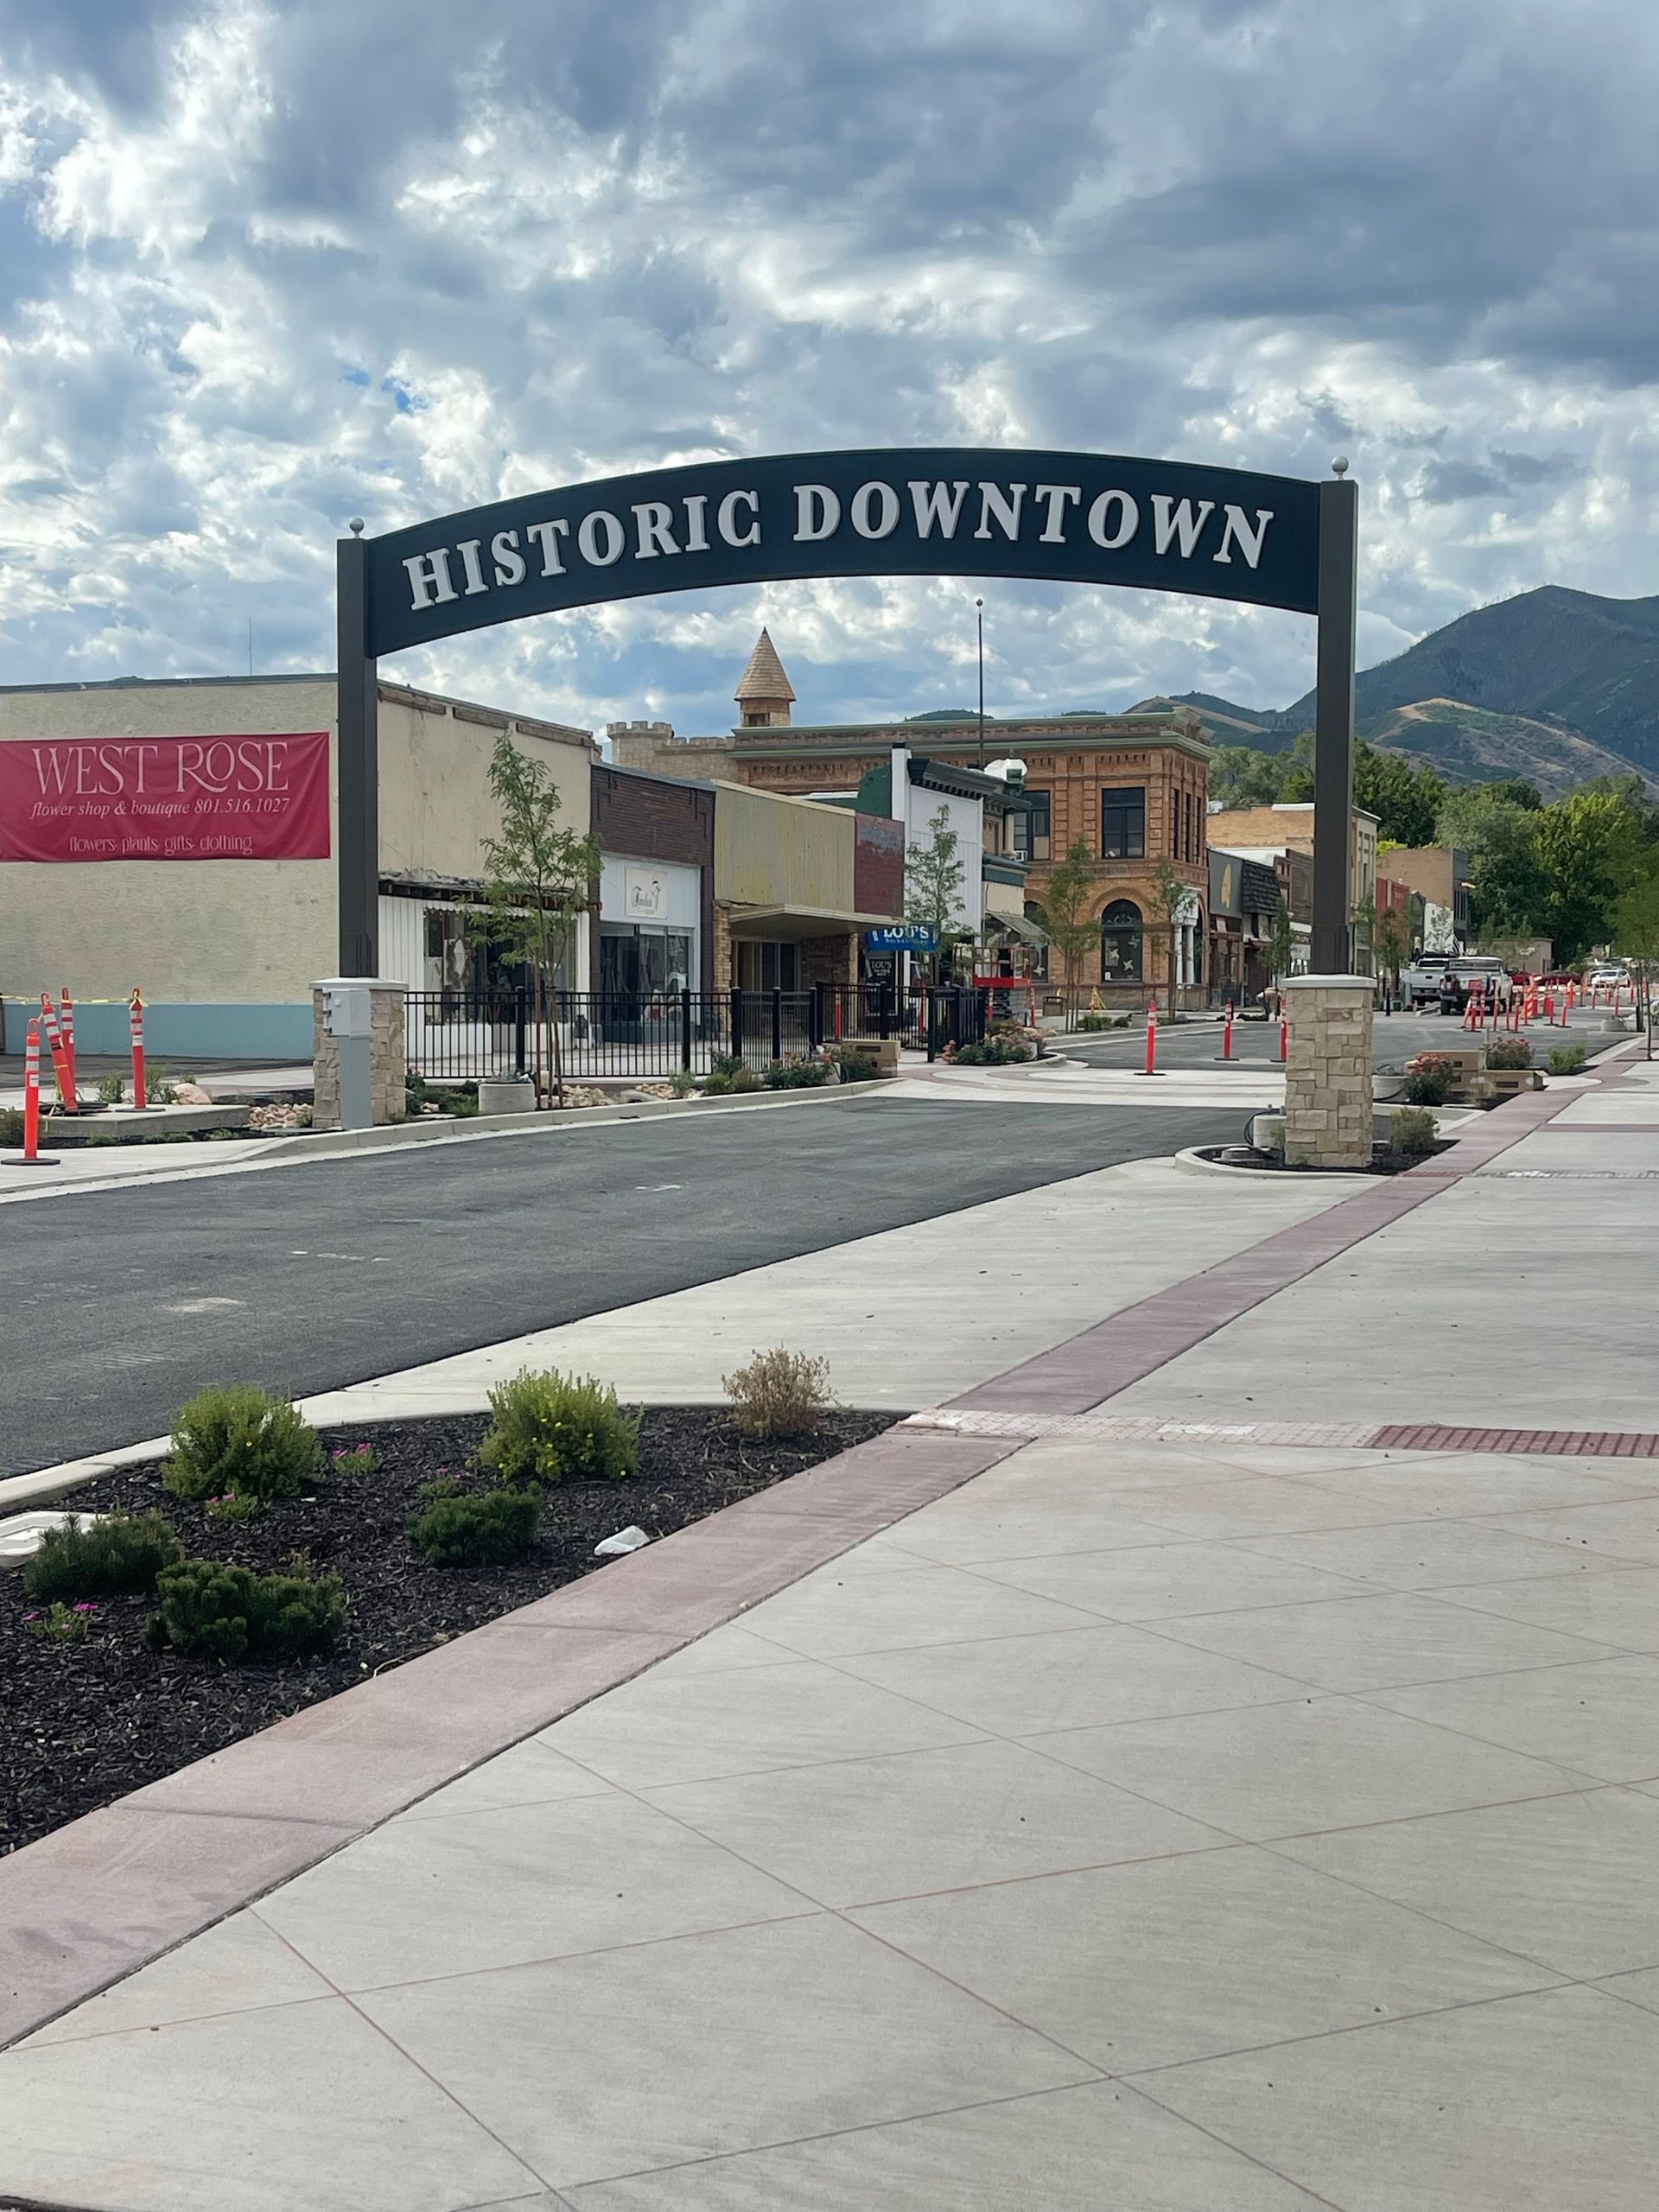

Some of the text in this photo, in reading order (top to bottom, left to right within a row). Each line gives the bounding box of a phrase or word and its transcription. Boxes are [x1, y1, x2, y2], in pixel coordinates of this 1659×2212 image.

[401, 480, 1274, 611] HISTORIC DOWNTOWN
[31, 741, 289, 795] WEST ROSE
[28, 798, 290, 820] flower shop & boutique 801.516.1027
[200, 835, 252, 855] clothing
